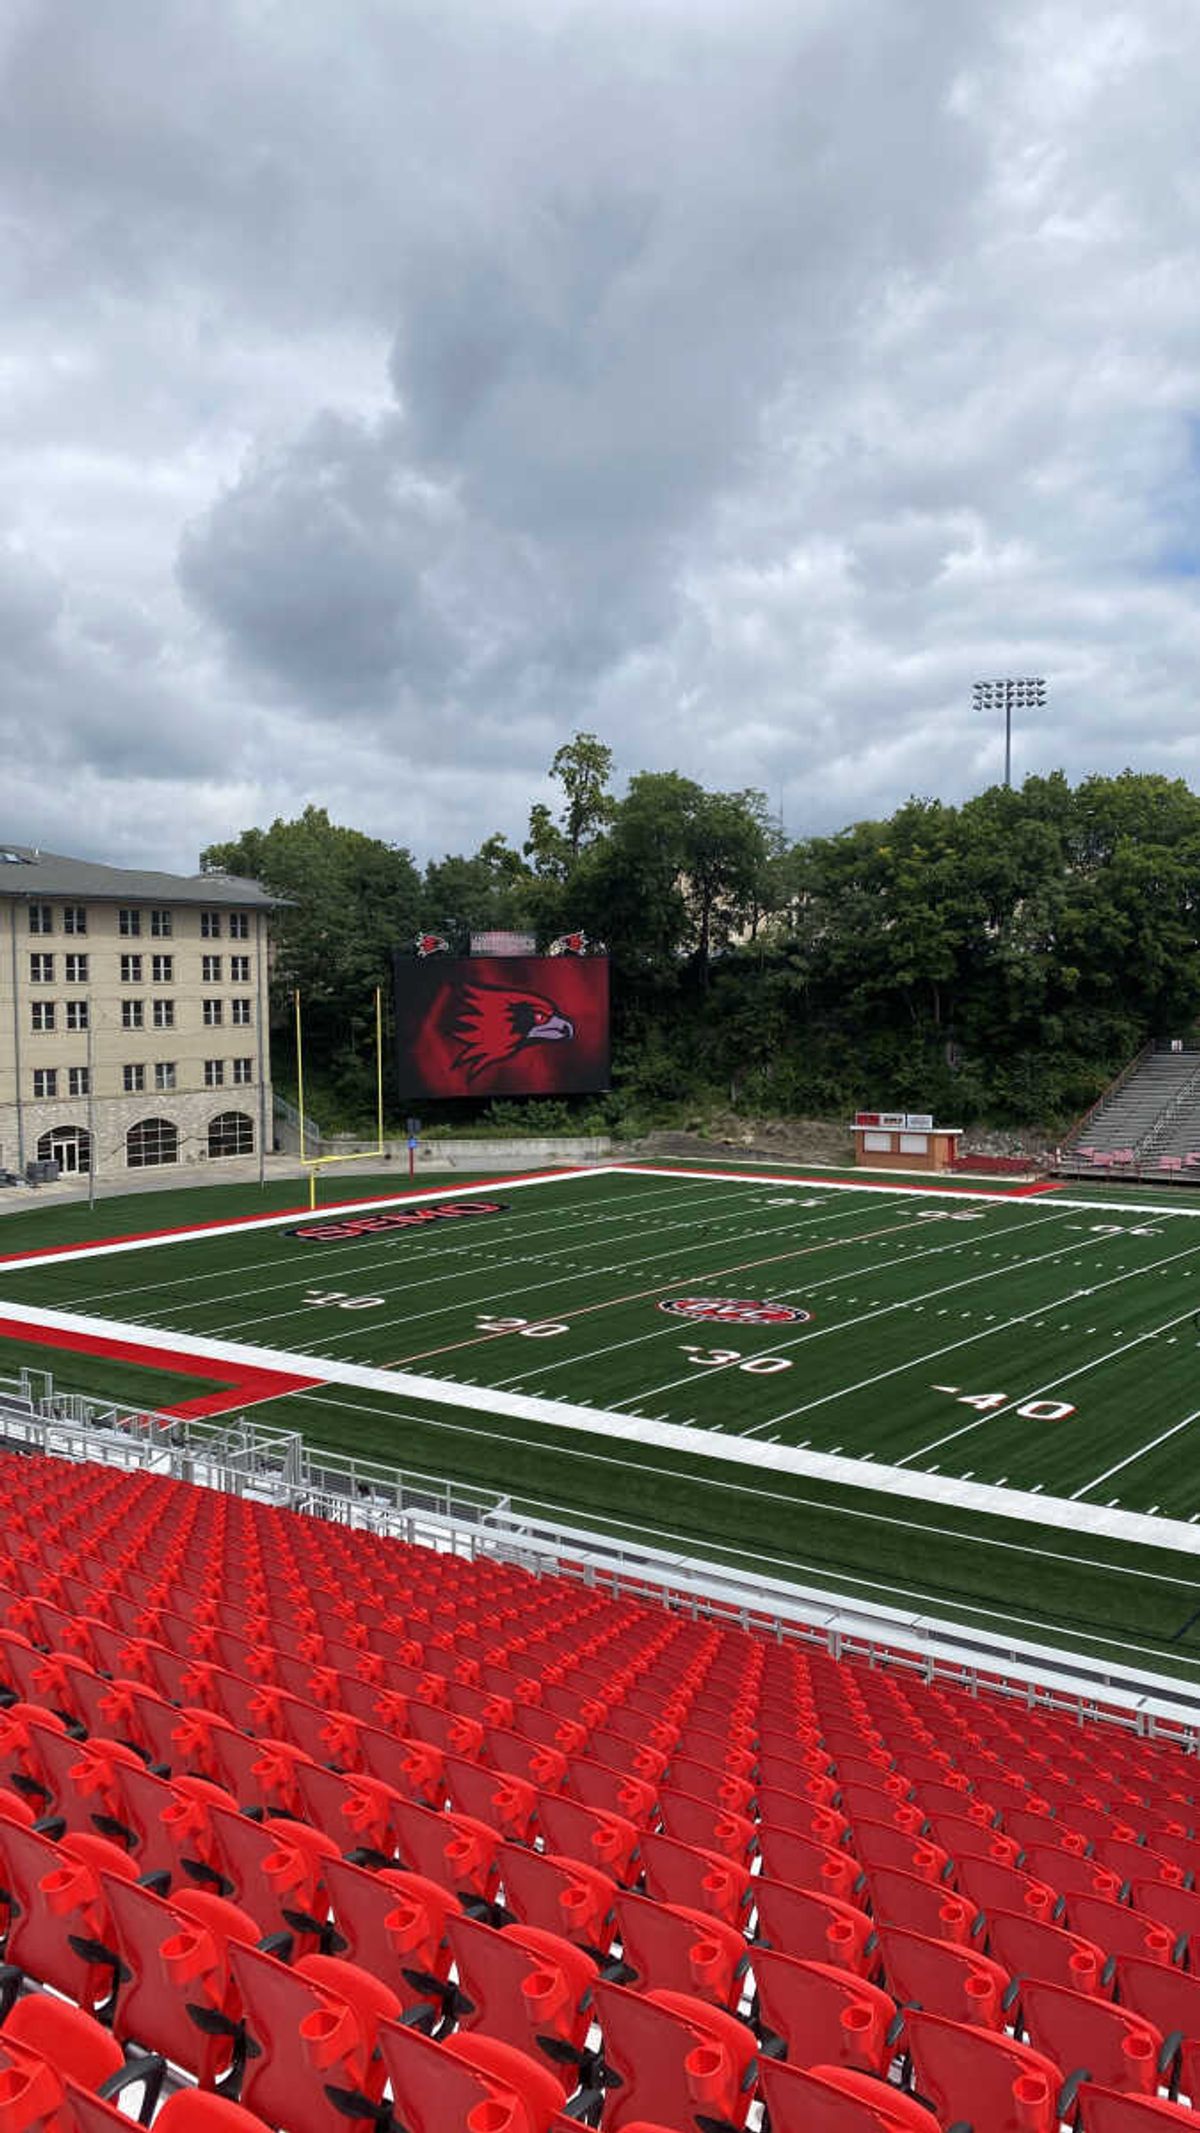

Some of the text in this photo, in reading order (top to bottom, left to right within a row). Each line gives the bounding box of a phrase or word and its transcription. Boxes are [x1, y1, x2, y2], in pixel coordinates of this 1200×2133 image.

[293, 1202, 502, 1241] SEMO
[475, 1317, 571, 1338] 20
[687, 1349, 794, 1375] 30
[956, 1393, 1077, 1421] 40
